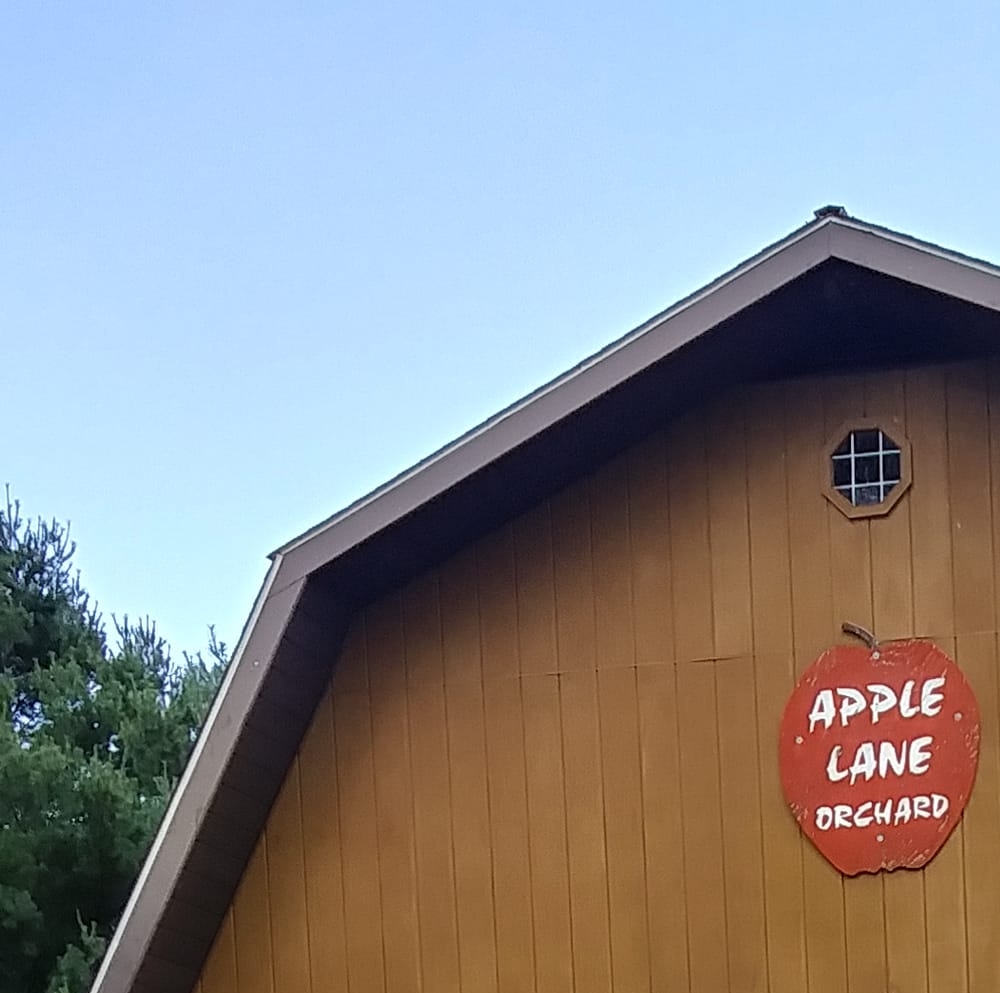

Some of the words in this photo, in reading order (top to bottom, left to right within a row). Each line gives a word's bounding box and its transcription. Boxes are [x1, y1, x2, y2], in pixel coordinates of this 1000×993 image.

[808, 676, 946, 733] APPLE
[826, 736, 933, 785] LANE
[815, 793, 949, 831] ORCHARD
